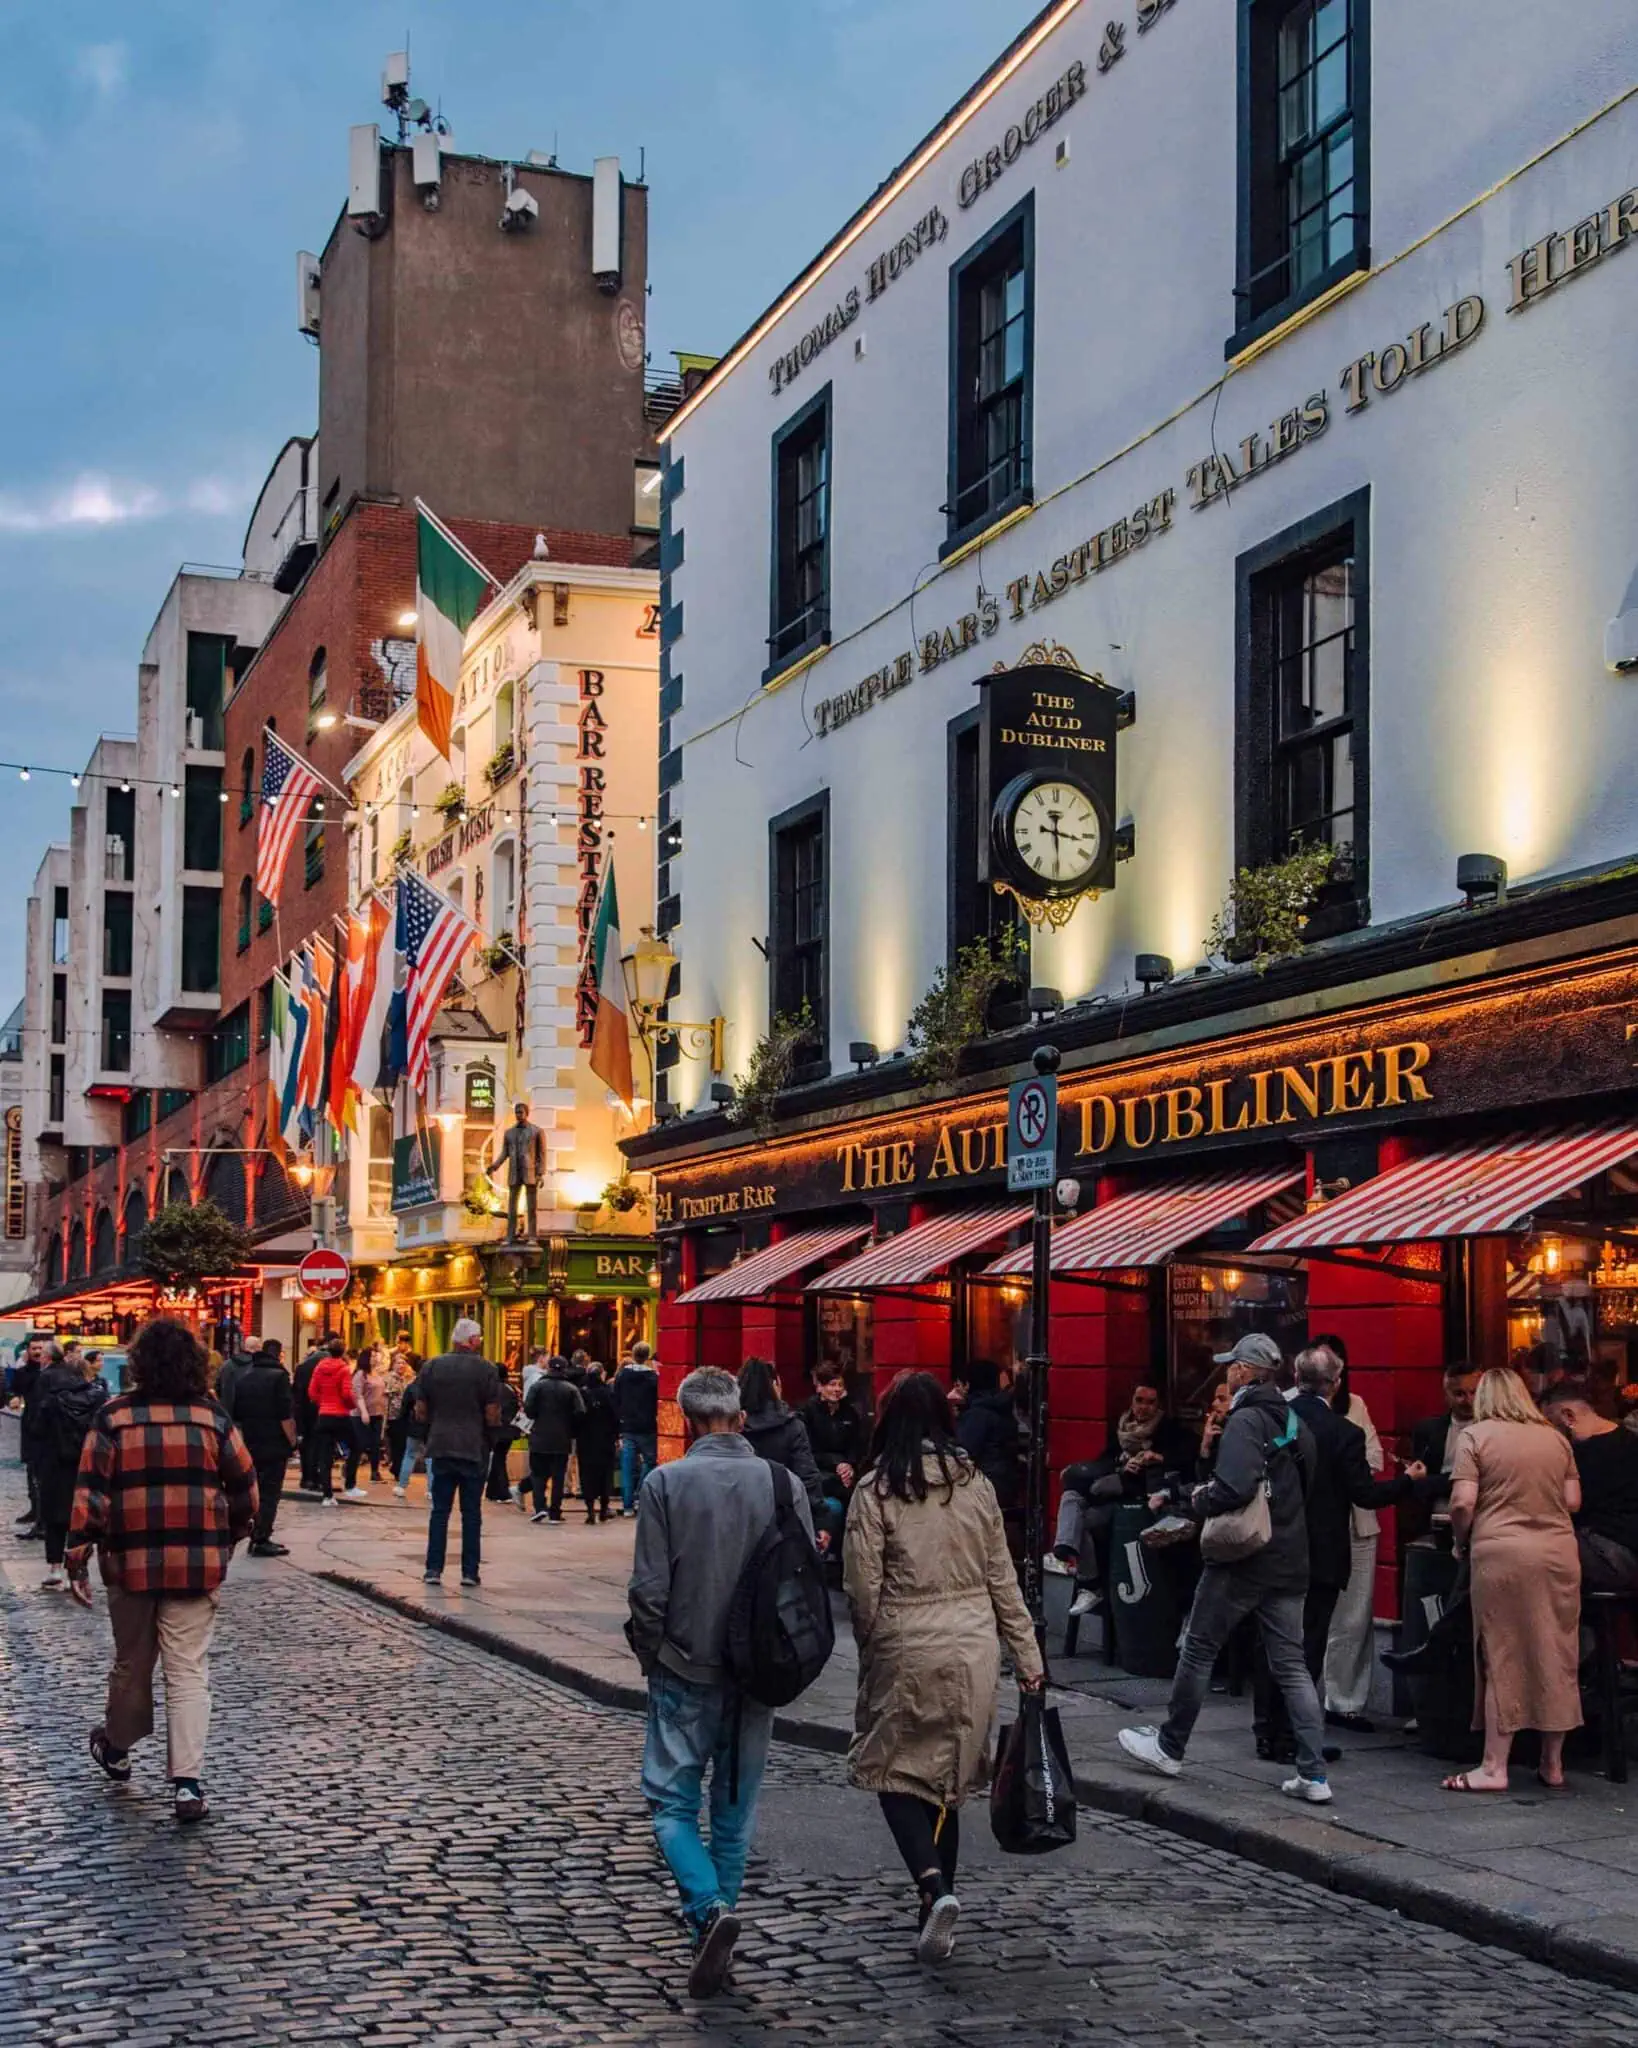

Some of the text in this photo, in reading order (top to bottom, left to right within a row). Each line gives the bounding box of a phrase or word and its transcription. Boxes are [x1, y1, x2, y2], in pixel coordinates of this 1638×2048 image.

[769, 286, 860, 396] THOMAS
[865, 205, 948, 304] HUNT,
[958, 60, 1087, 208] GROCER
[1097, 20, 1126, 75] &
[814, 651, 913, 737] TEMPLE
[917, 584, 1000, 674] BAR'S
[1006, 487, 1178, 620] TASTIEST
[1186, 390, 1329, 511] TALES
[1338, 295, 1486, 415] TOLD
[577, 669, 607, 759] BAR
[1025, 711, 1082, 731] AULD
[1032, 691, 1076, 710] THE
[1001, 728, 1107, 753] DUBLINER
[427, 802, 496, 878] IRISH MUSIC
[837, 1041, 1434, 1192] THE AUL DUBLINER
[680, 1191, 740, 1219] TEMPLE
[743, 1185, 777, 1210] BAR
[596, 1255, 645, 1277] BAR
[1118, 1541, 1152, 1604] J
